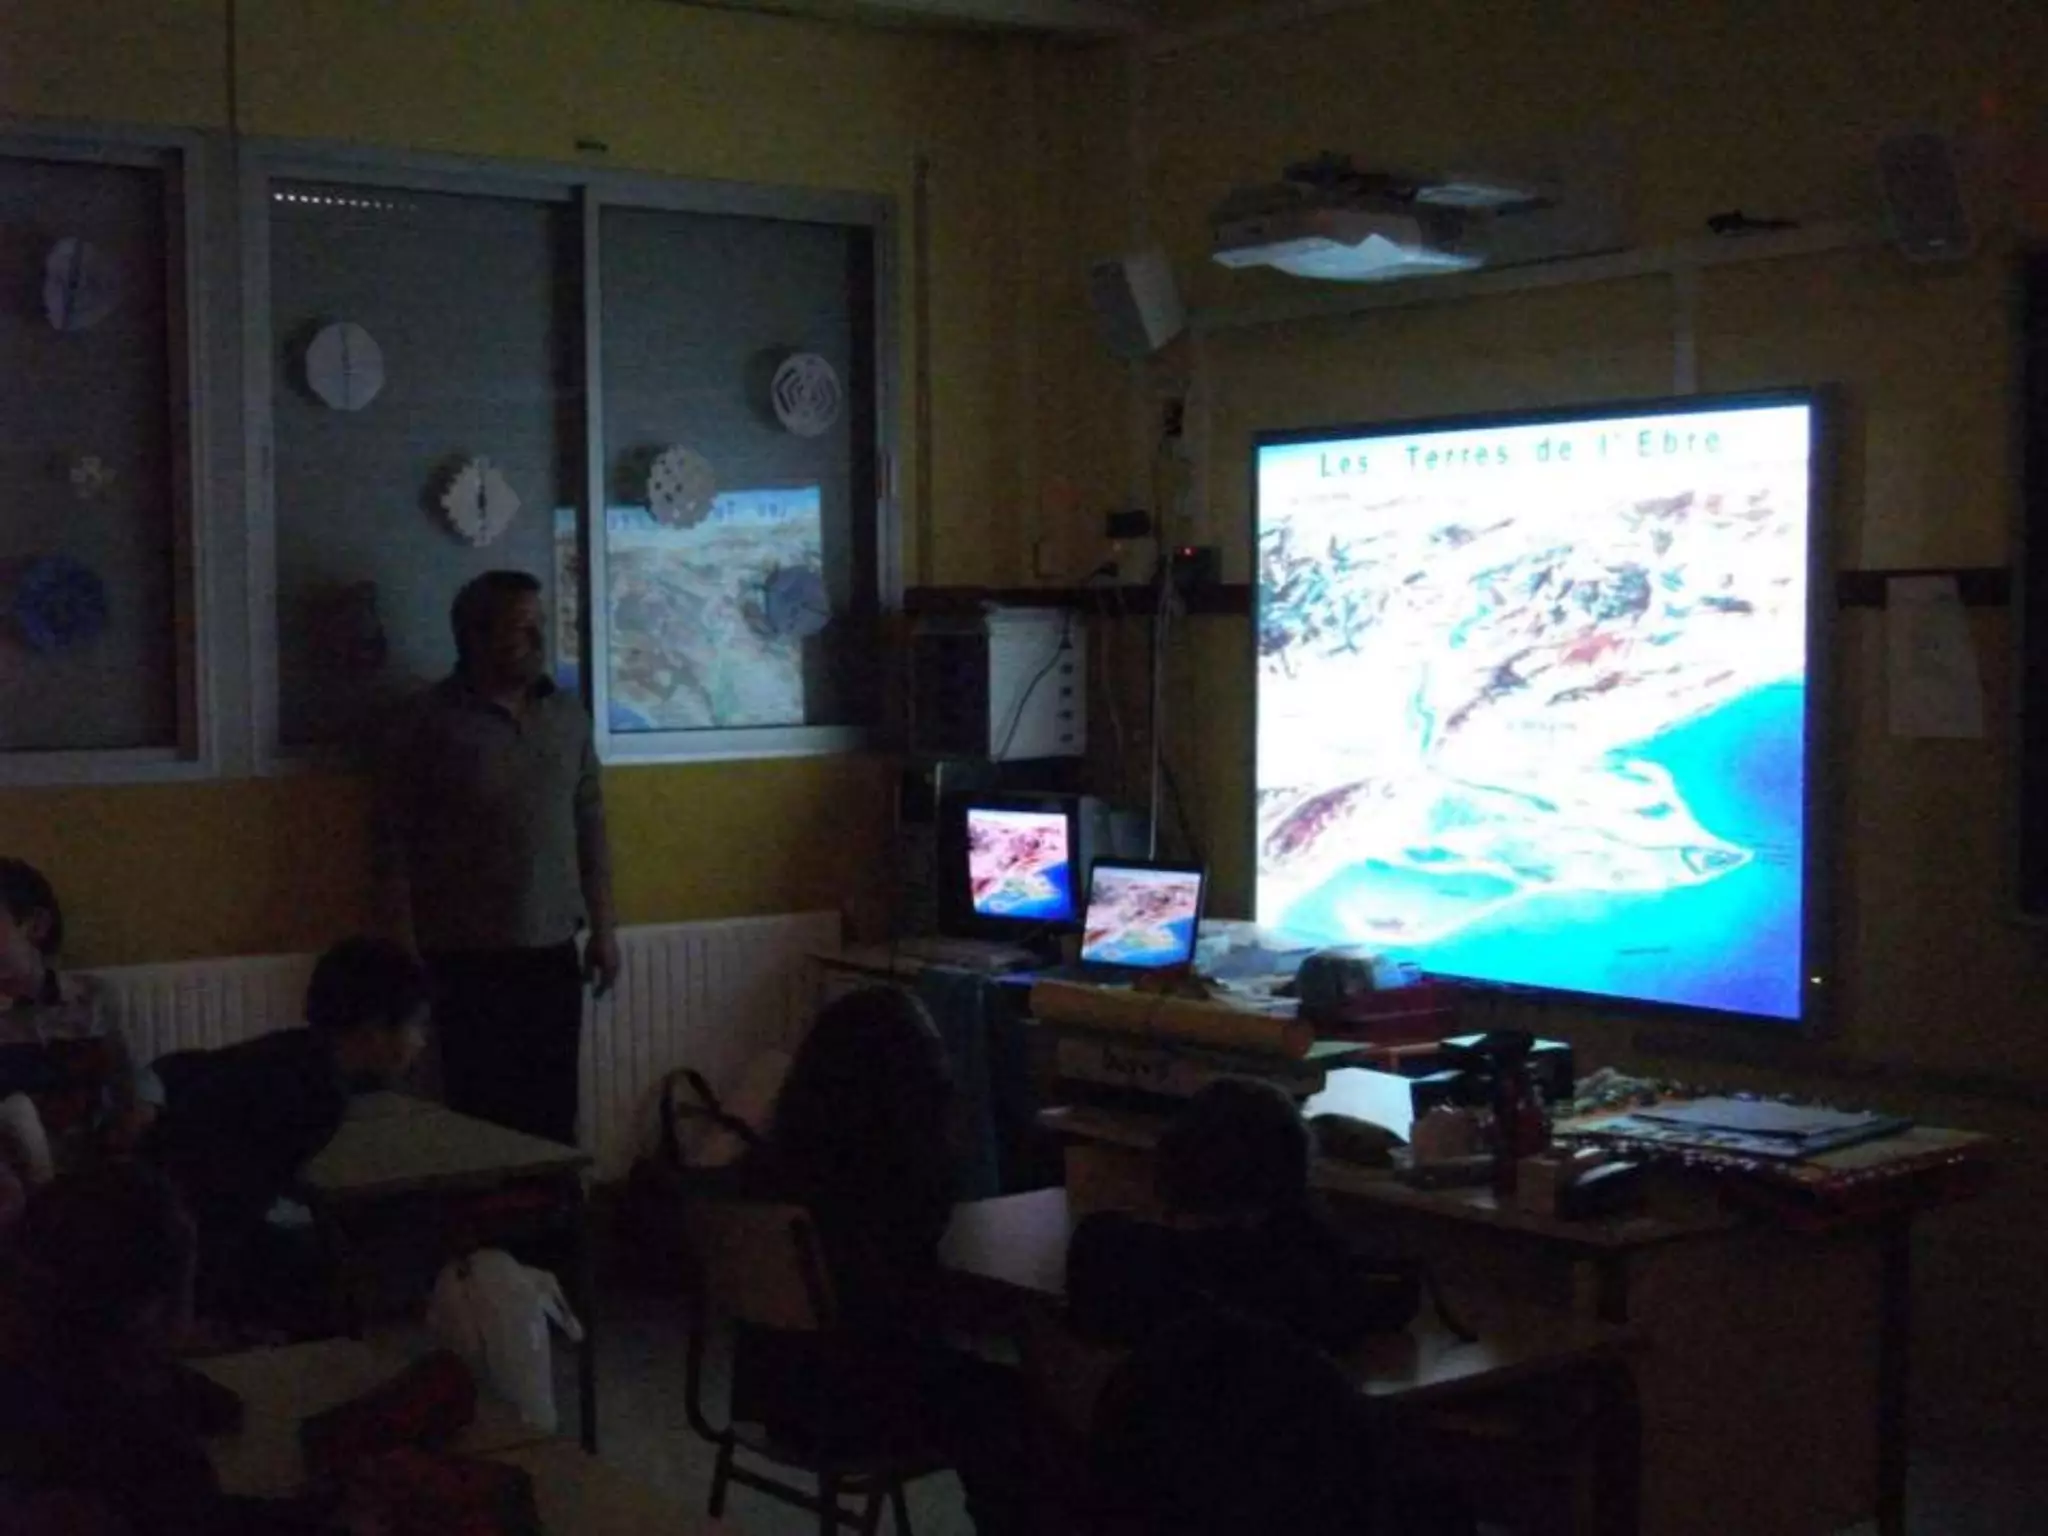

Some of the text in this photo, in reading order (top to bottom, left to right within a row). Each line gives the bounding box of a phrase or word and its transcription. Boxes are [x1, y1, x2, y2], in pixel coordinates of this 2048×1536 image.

[1320, 453, 1368, 478] Les
[1405, 444, 1509, 470] Terres
[1536, 437, 1572, 462] de
